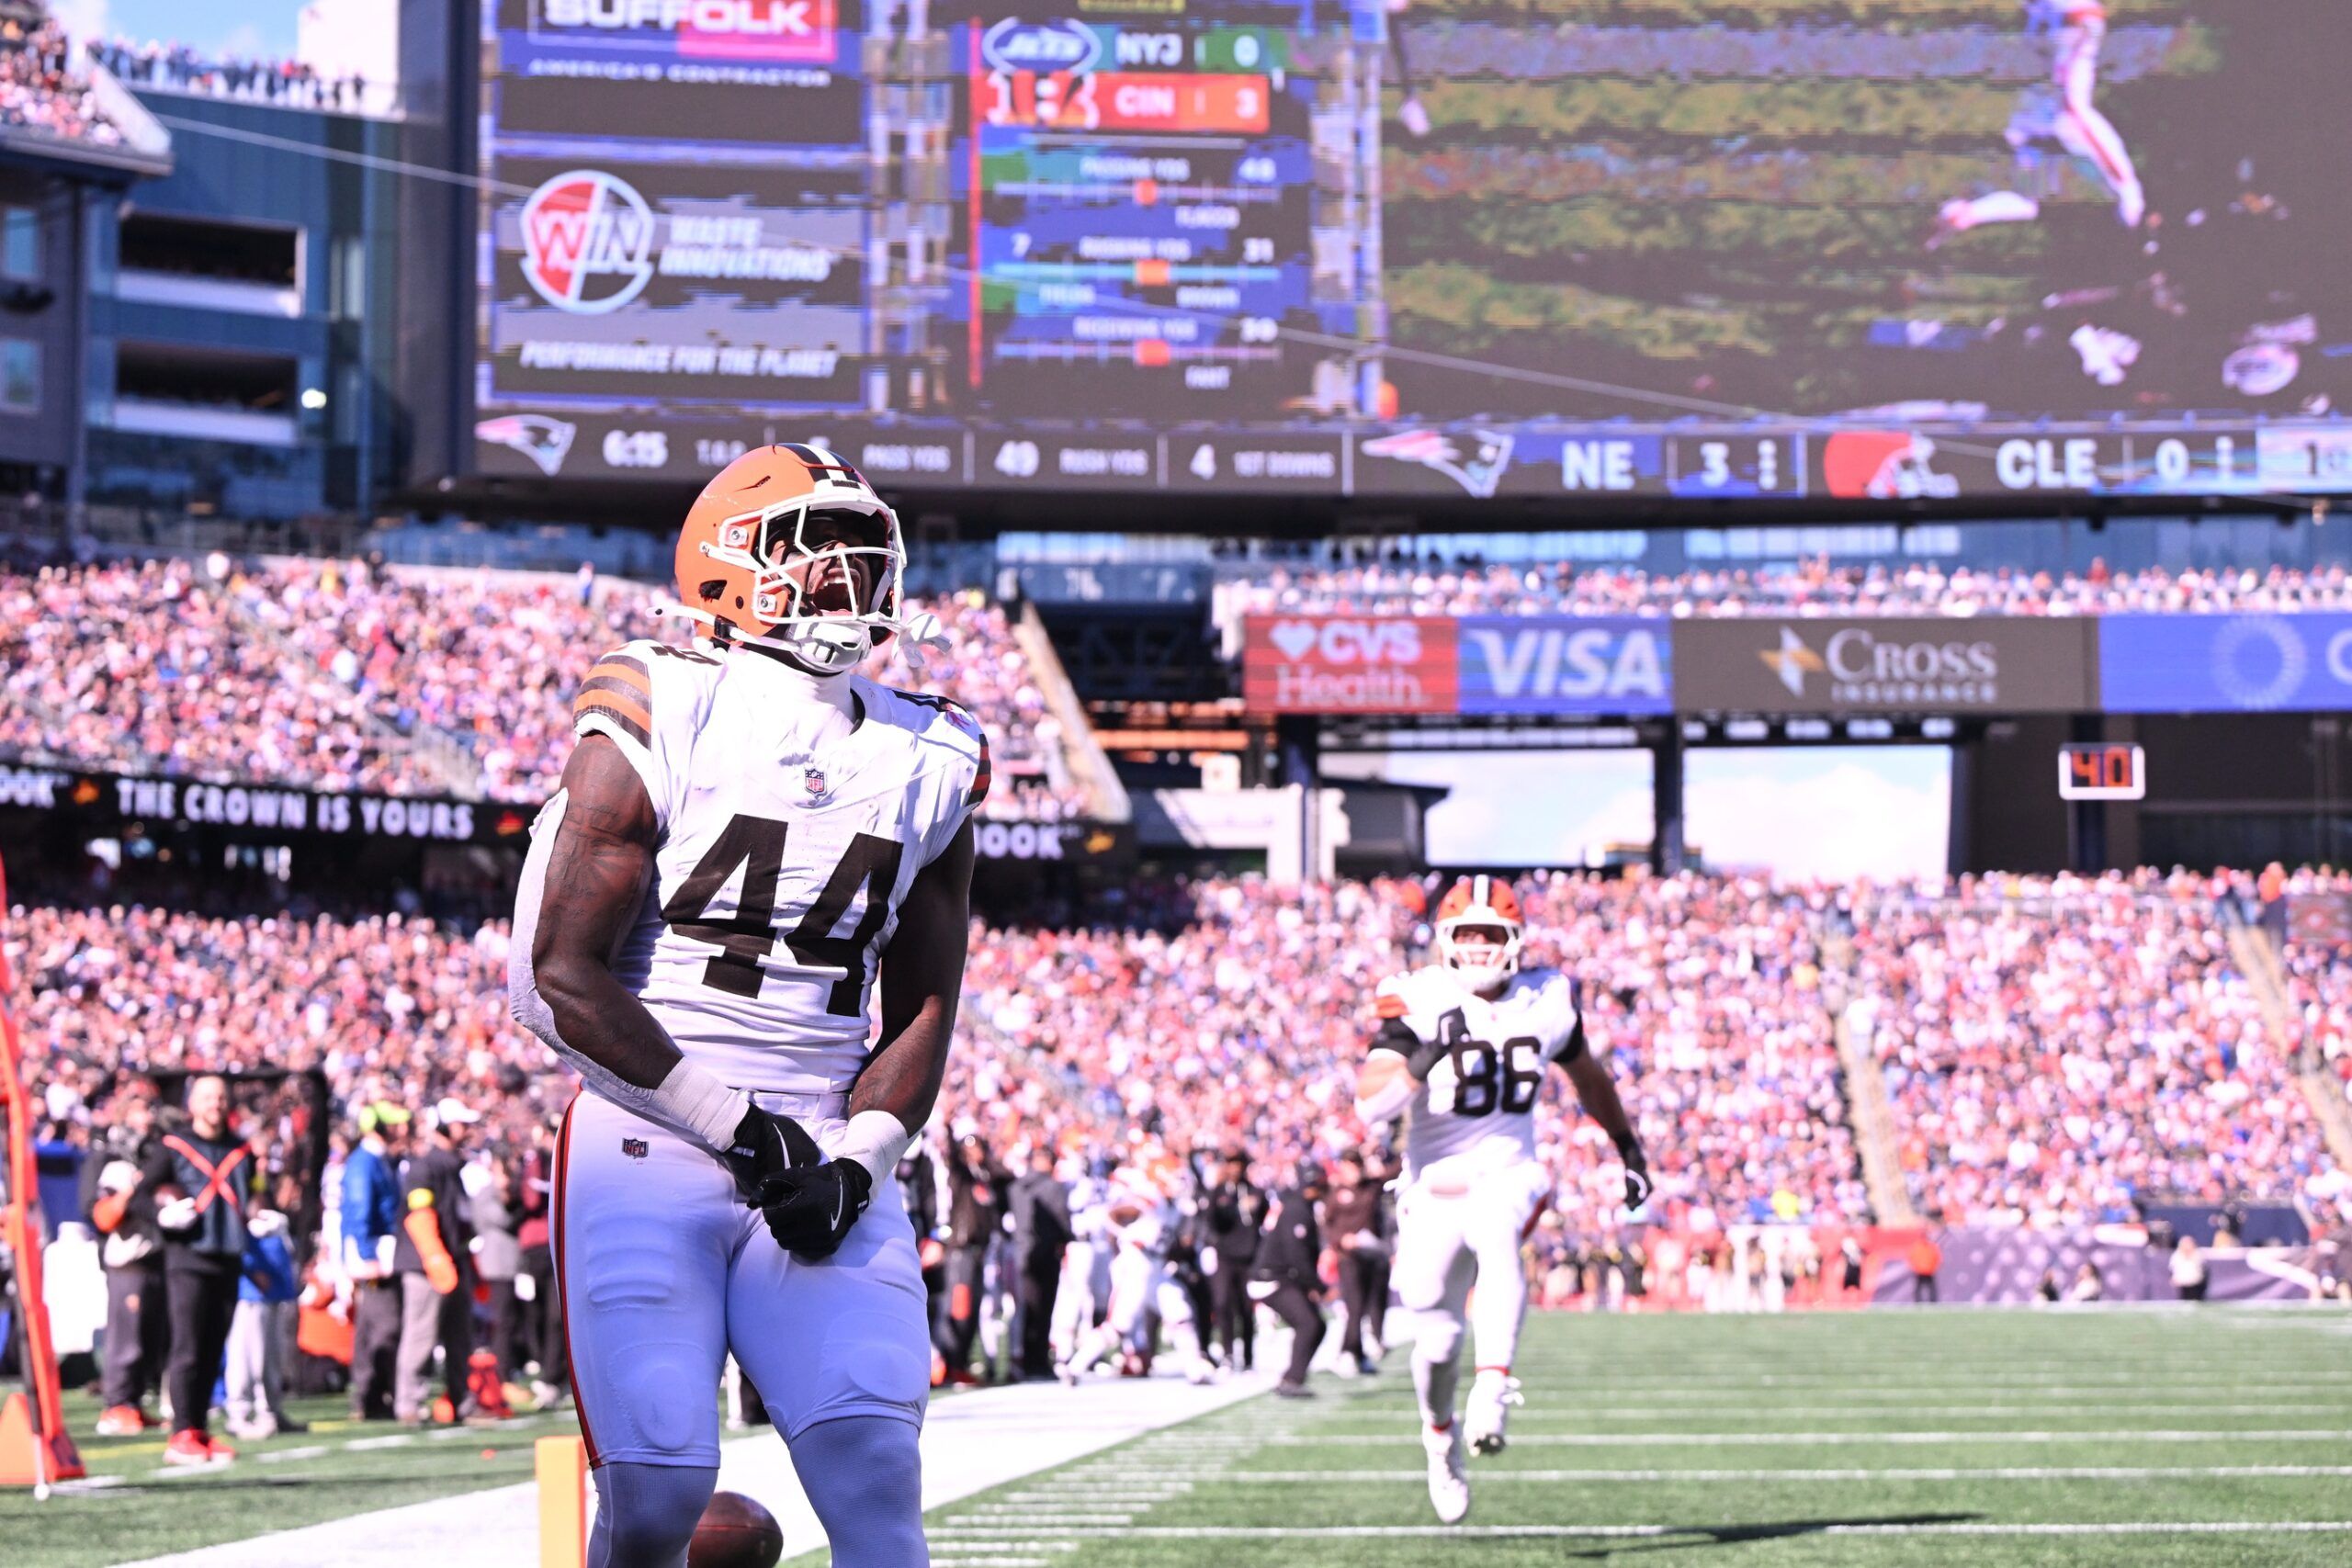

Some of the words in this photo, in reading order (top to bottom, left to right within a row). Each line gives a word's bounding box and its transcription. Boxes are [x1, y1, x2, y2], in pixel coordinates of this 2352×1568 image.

[544, 0, 812, 35] SUFFOLK
[1115, 32, 1182, 66] NYJ
[1114, 85, 1176, 118] CIN
[1235, 87, 1260, 119] 3
[519, 340, 671, 374] PERFORMANCE
[673, 344, 717, 374] FOR
[718, 346, 758, 376] THE
[760, 348, 840, 378] PLANET
[1190, 444, 1216, 480] 4
[1562, 441, 1635, 491] NE
[1700, 441, 1729, 488] 3
[1996, 438, 2098, 490] CLE
[2155, 438, 2188, 483] 0
[1319, 620, 1422, 665] CVS
[1466, 628, 1666, 699] VISA
[1276, 664, 1424, 707] Health
[2072, 746, 2132, 788] 40
[116, 779, 175, 818] THE
[185, 784, 307, 830] CROWN
[317, 794, 351, 832] IS
[360, 796, 474, 840] YOURS
[973, 823, 1064, 860] OOK
[660, 814, 903, 1017] 44
[1451, 1034, 1542, 1116] 86
